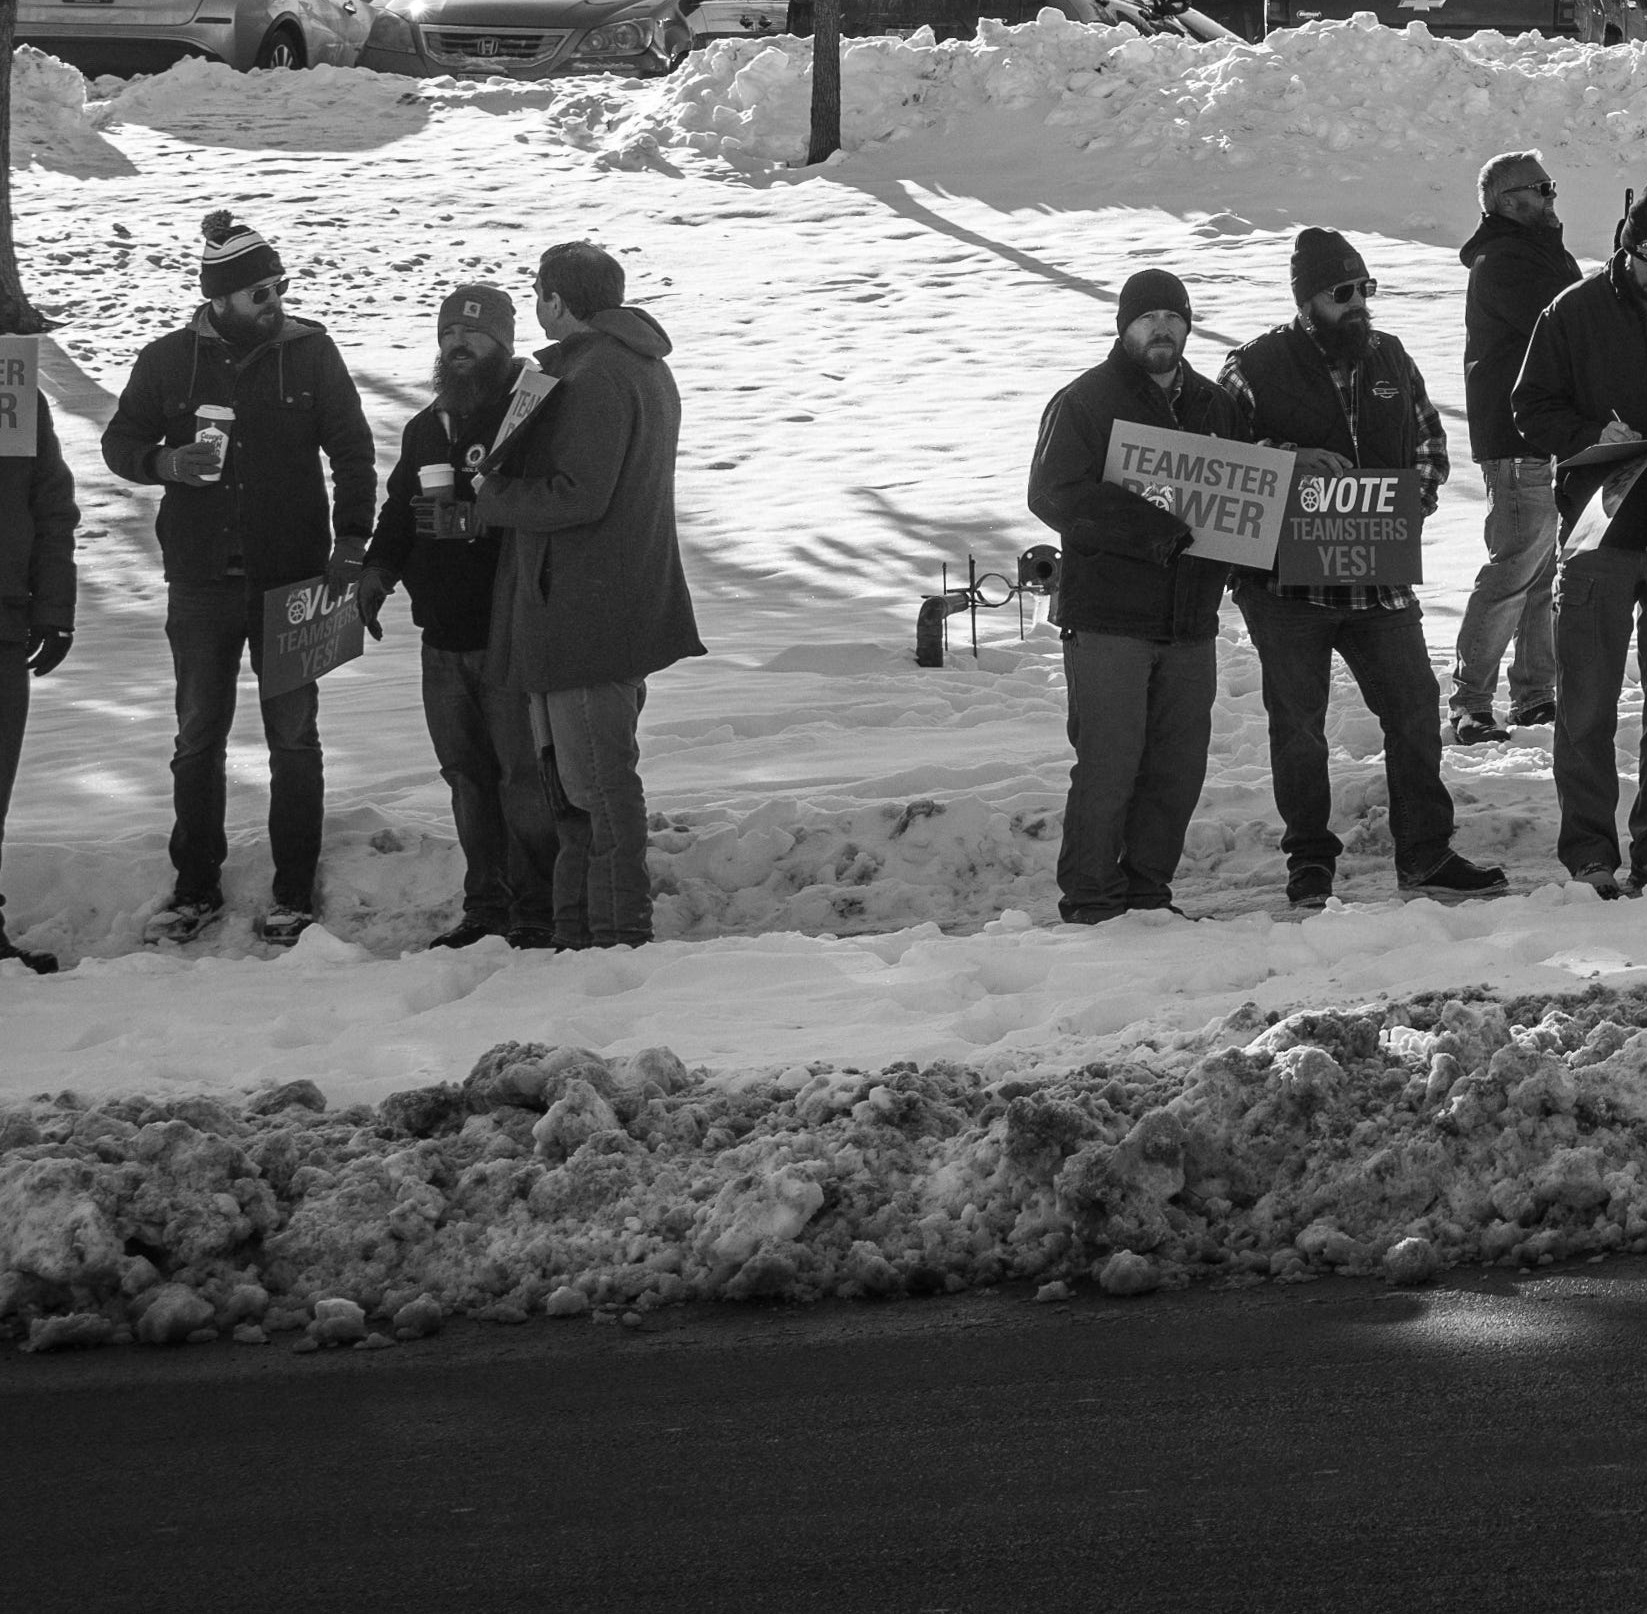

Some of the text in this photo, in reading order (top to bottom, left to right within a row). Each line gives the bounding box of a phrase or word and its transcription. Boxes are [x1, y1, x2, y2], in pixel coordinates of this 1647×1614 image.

[1120, 443, 1280, 498] TEAMSTER
[1318, 477, 1399, 513] VOTE
[1290, 518, 1408, 541] TEAMSTERS
[1317, 545, 1377, 577] YES!
